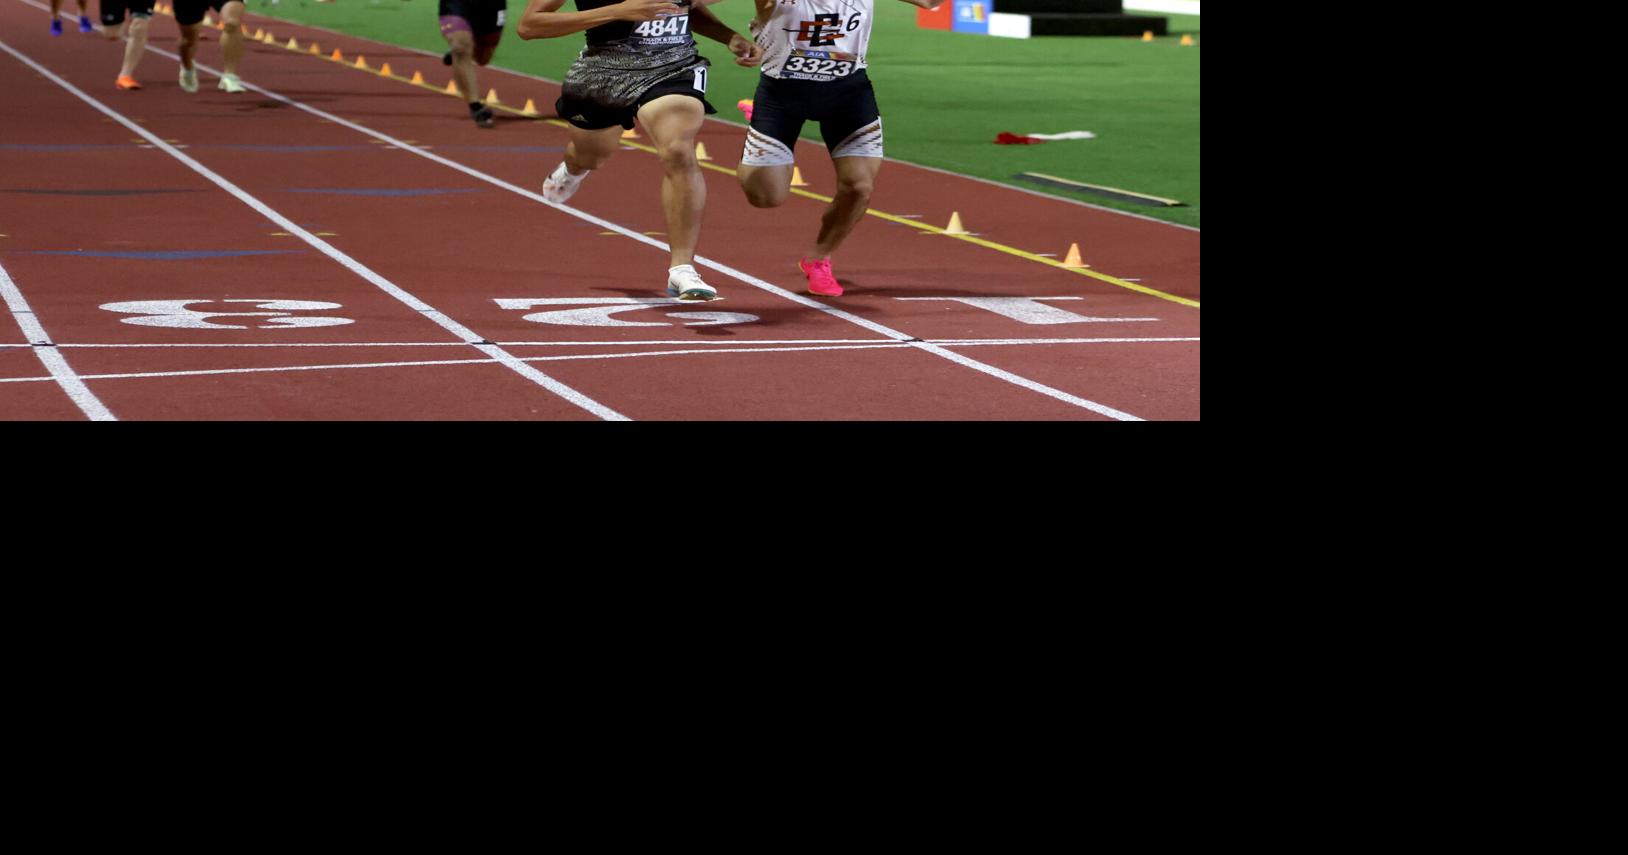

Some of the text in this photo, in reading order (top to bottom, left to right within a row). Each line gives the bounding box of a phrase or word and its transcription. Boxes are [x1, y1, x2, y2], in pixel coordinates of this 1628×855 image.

[634, 16, 689, 37] 4847
[845, 12, 861, 31] 6
[786, 57, 852, 76] 3323
[98, 299, 355, 330] 3
[494, 297, 760, 327] 2
[893, 296, 1160, 325] 1
